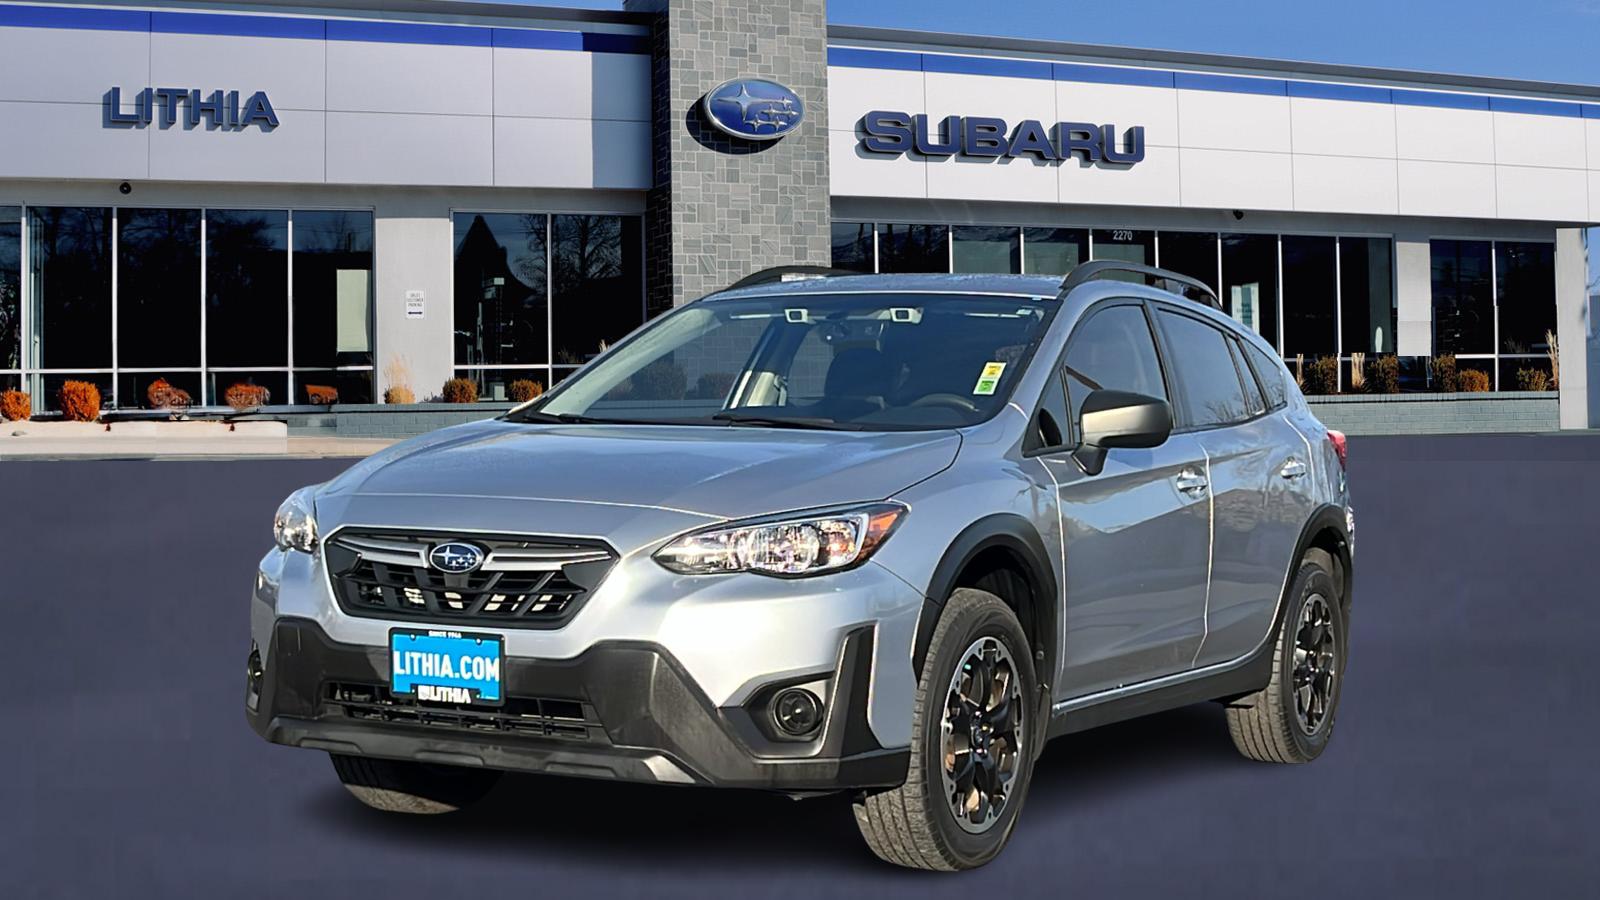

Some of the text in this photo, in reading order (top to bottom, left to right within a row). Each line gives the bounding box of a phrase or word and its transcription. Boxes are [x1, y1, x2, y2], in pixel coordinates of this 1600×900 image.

[106, 86, 279, 130] LITHIA
[856, 110, 1145, 168] SUBARU
[1113, 230, 1133, 241] 2270
[393, 650, 500, 682] LITHIA.COM
[429, 685, 472, 704] LITHIA
